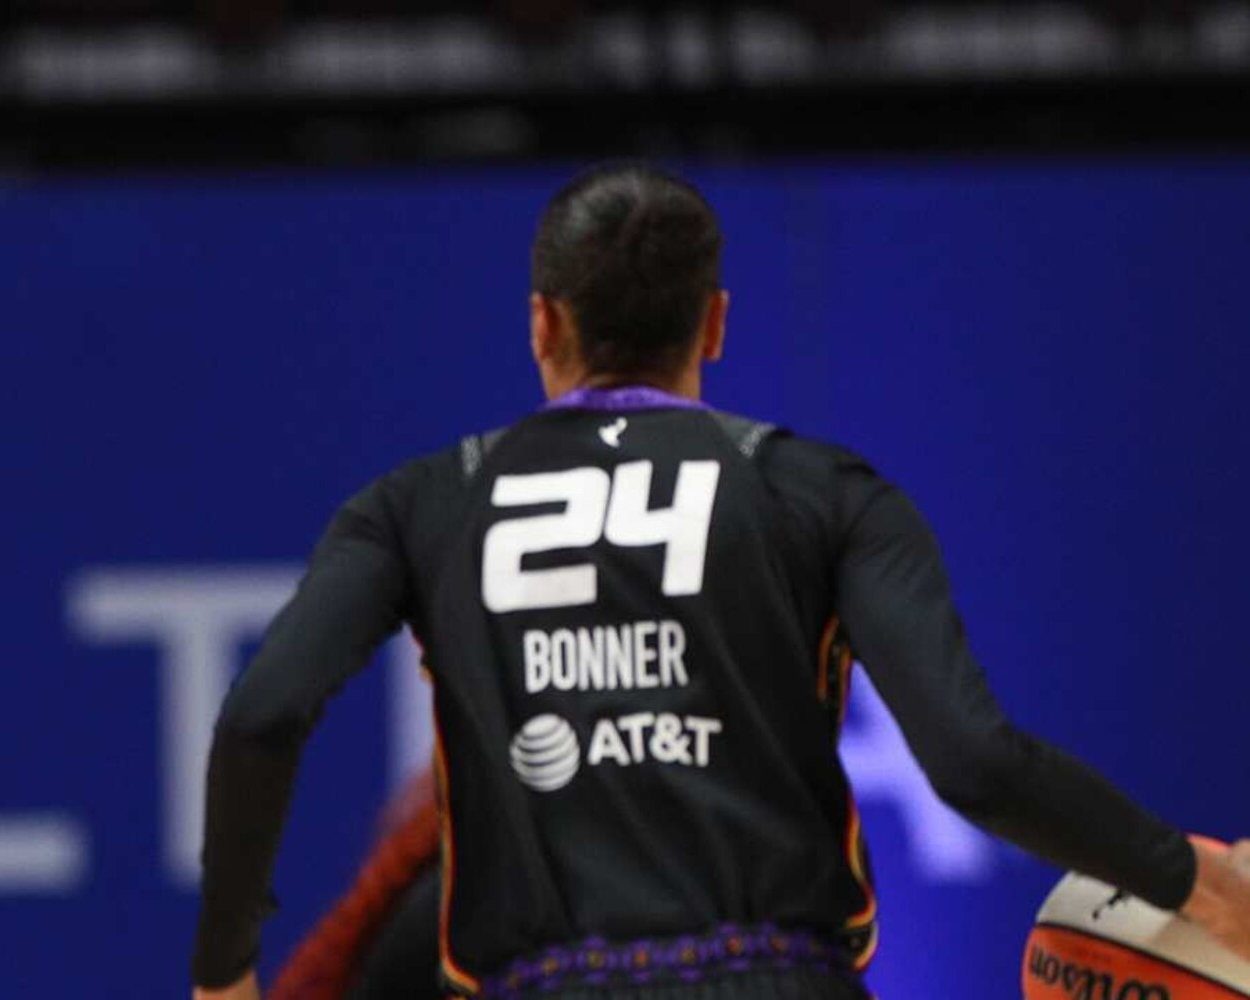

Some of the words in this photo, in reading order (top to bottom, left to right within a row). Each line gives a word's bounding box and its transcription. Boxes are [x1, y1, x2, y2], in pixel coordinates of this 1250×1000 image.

[482, 459, 721, 613] 24
[523, 620, 689, 693] BONNER
[587, 712, 722, 767] AT&T
